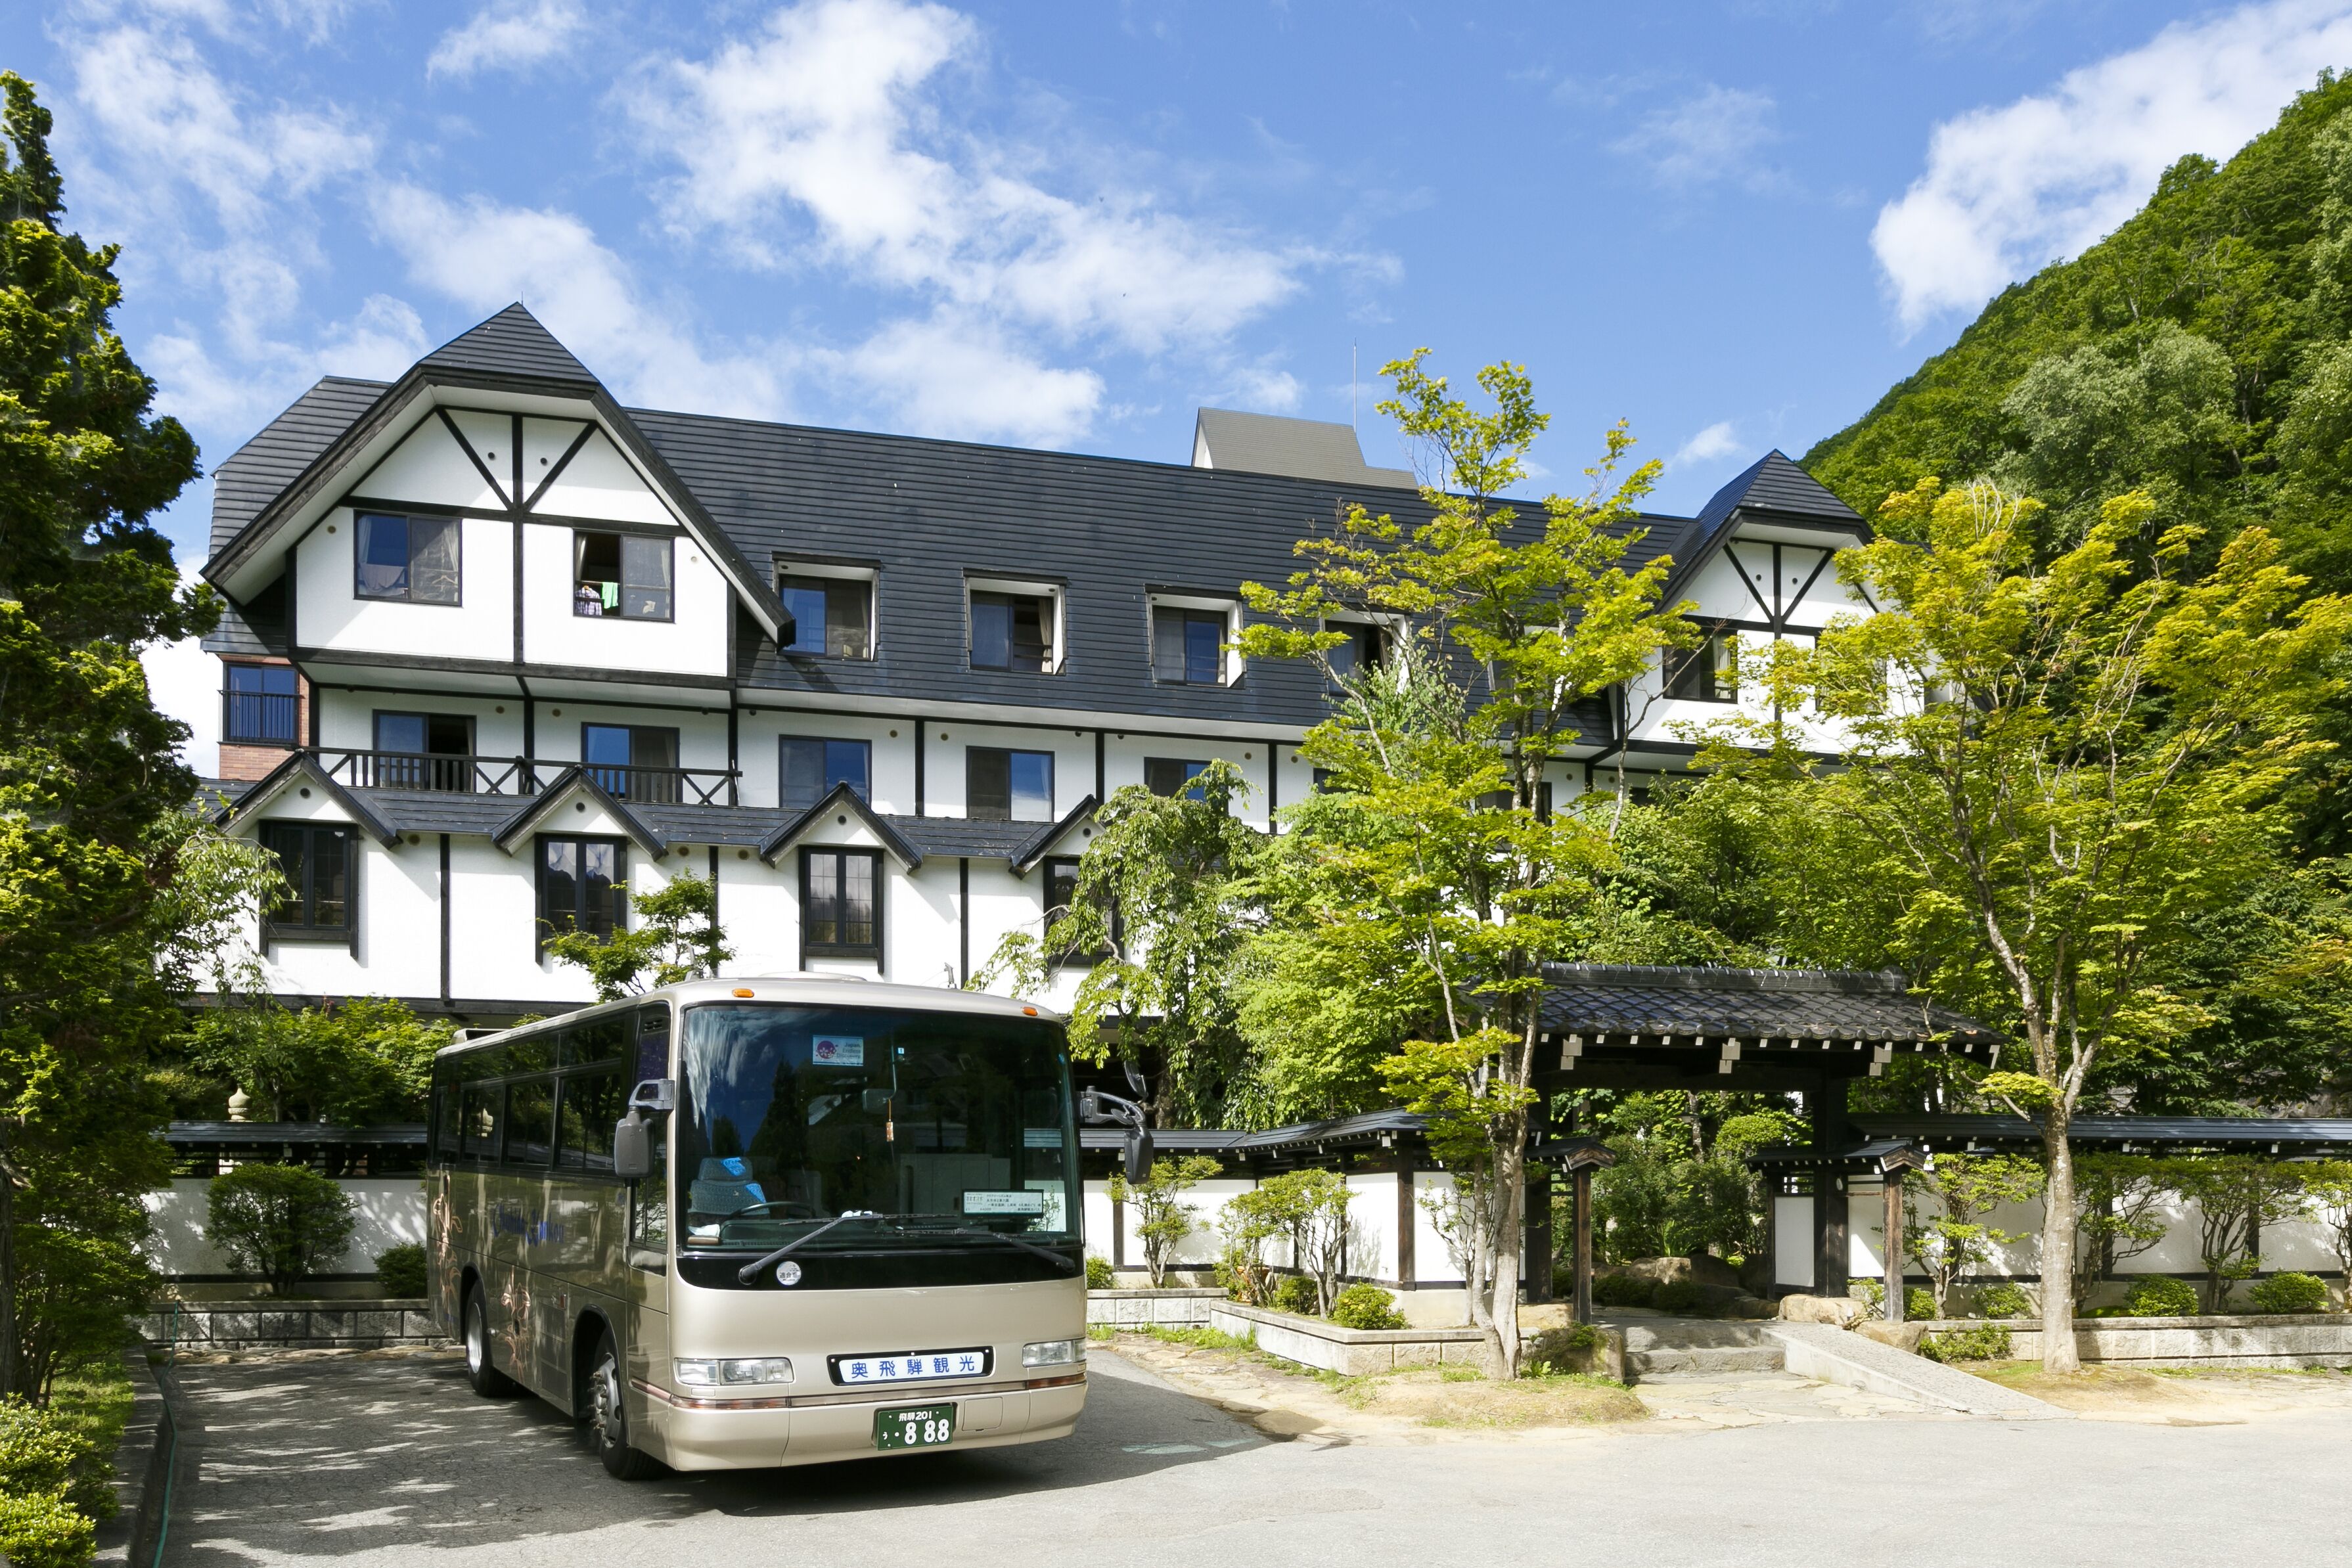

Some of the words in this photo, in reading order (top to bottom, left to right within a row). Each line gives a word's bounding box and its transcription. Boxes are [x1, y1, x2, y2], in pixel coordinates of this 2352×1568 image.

[851, 1355, 975, 1379] 奥飛騨観光
